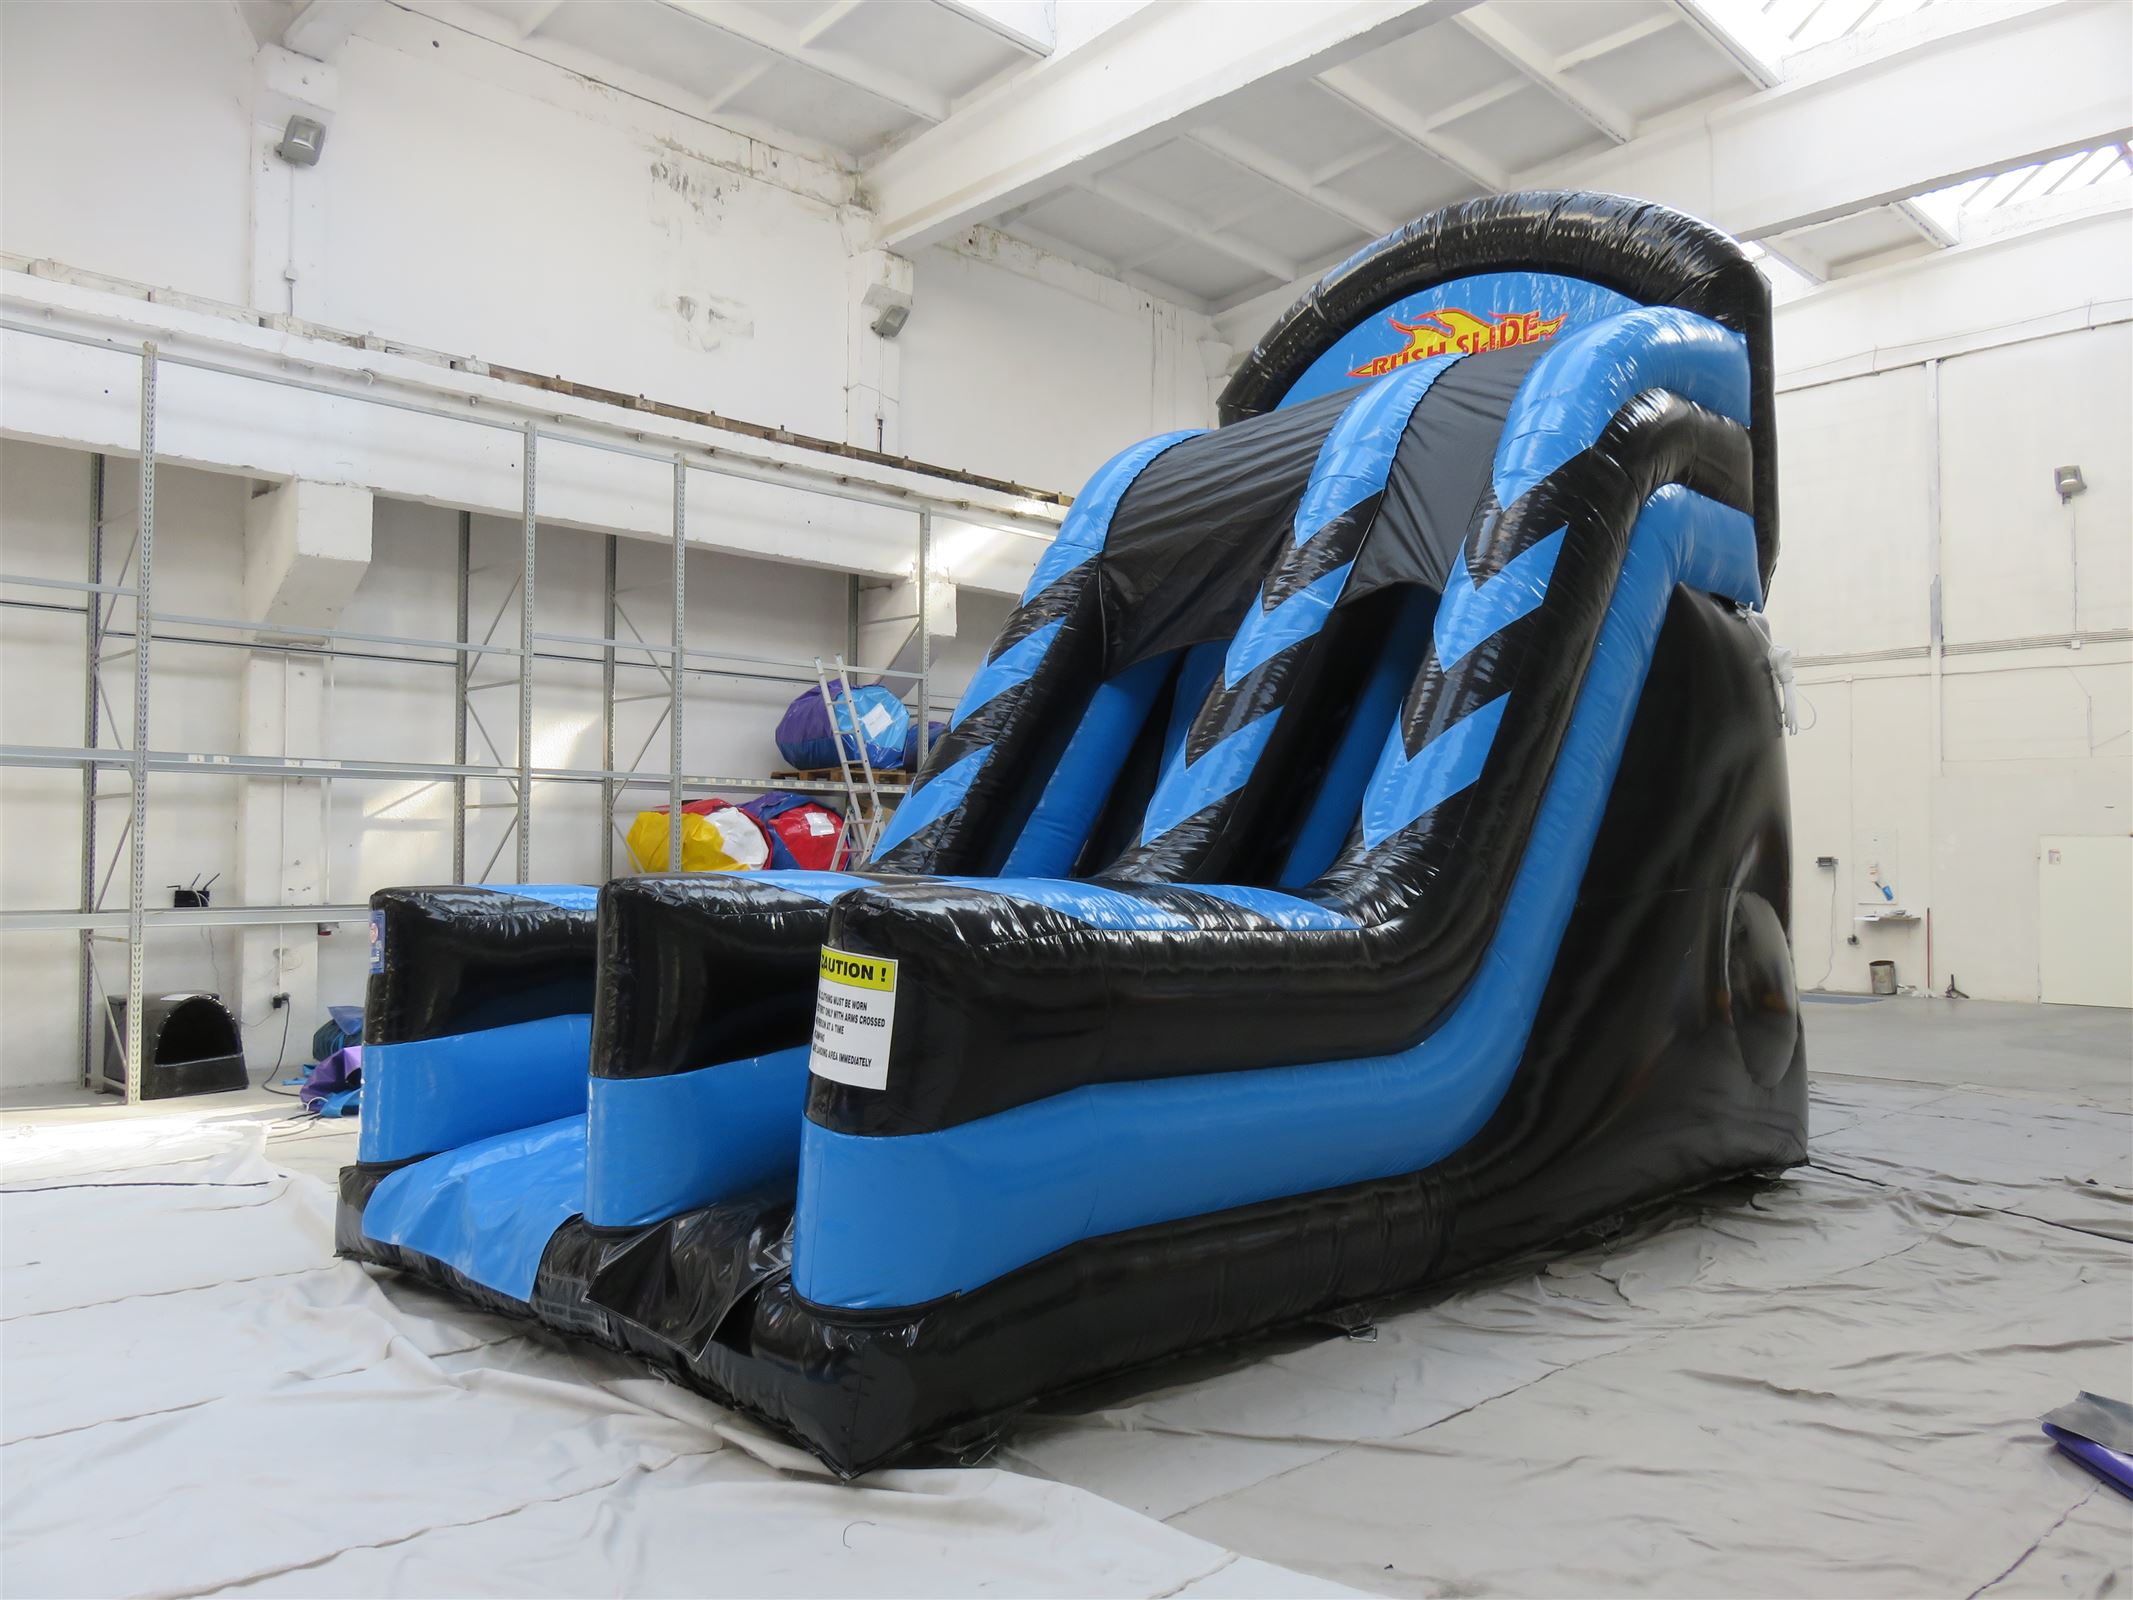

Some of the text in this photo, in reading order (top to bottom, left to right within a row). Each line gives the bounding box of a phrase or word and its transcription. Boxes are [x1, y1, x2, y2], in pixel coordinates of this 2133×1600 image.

[1371, 311, 1540, 376] RUSH SLIDE
[880, 967, 887, 982] !
[833, 996, 845, 1006] MUST
[844, 998, 851, 1009] BE
[851, 1000, 868, 1011] WORN
[844, 1012, 859, 1024] ARMS
[859, 1015, 886, 1027] CROSSED
[834, 1024, 845, 1035] TIME
[839, 1053, 872, 1067] IMMEDIATELY
